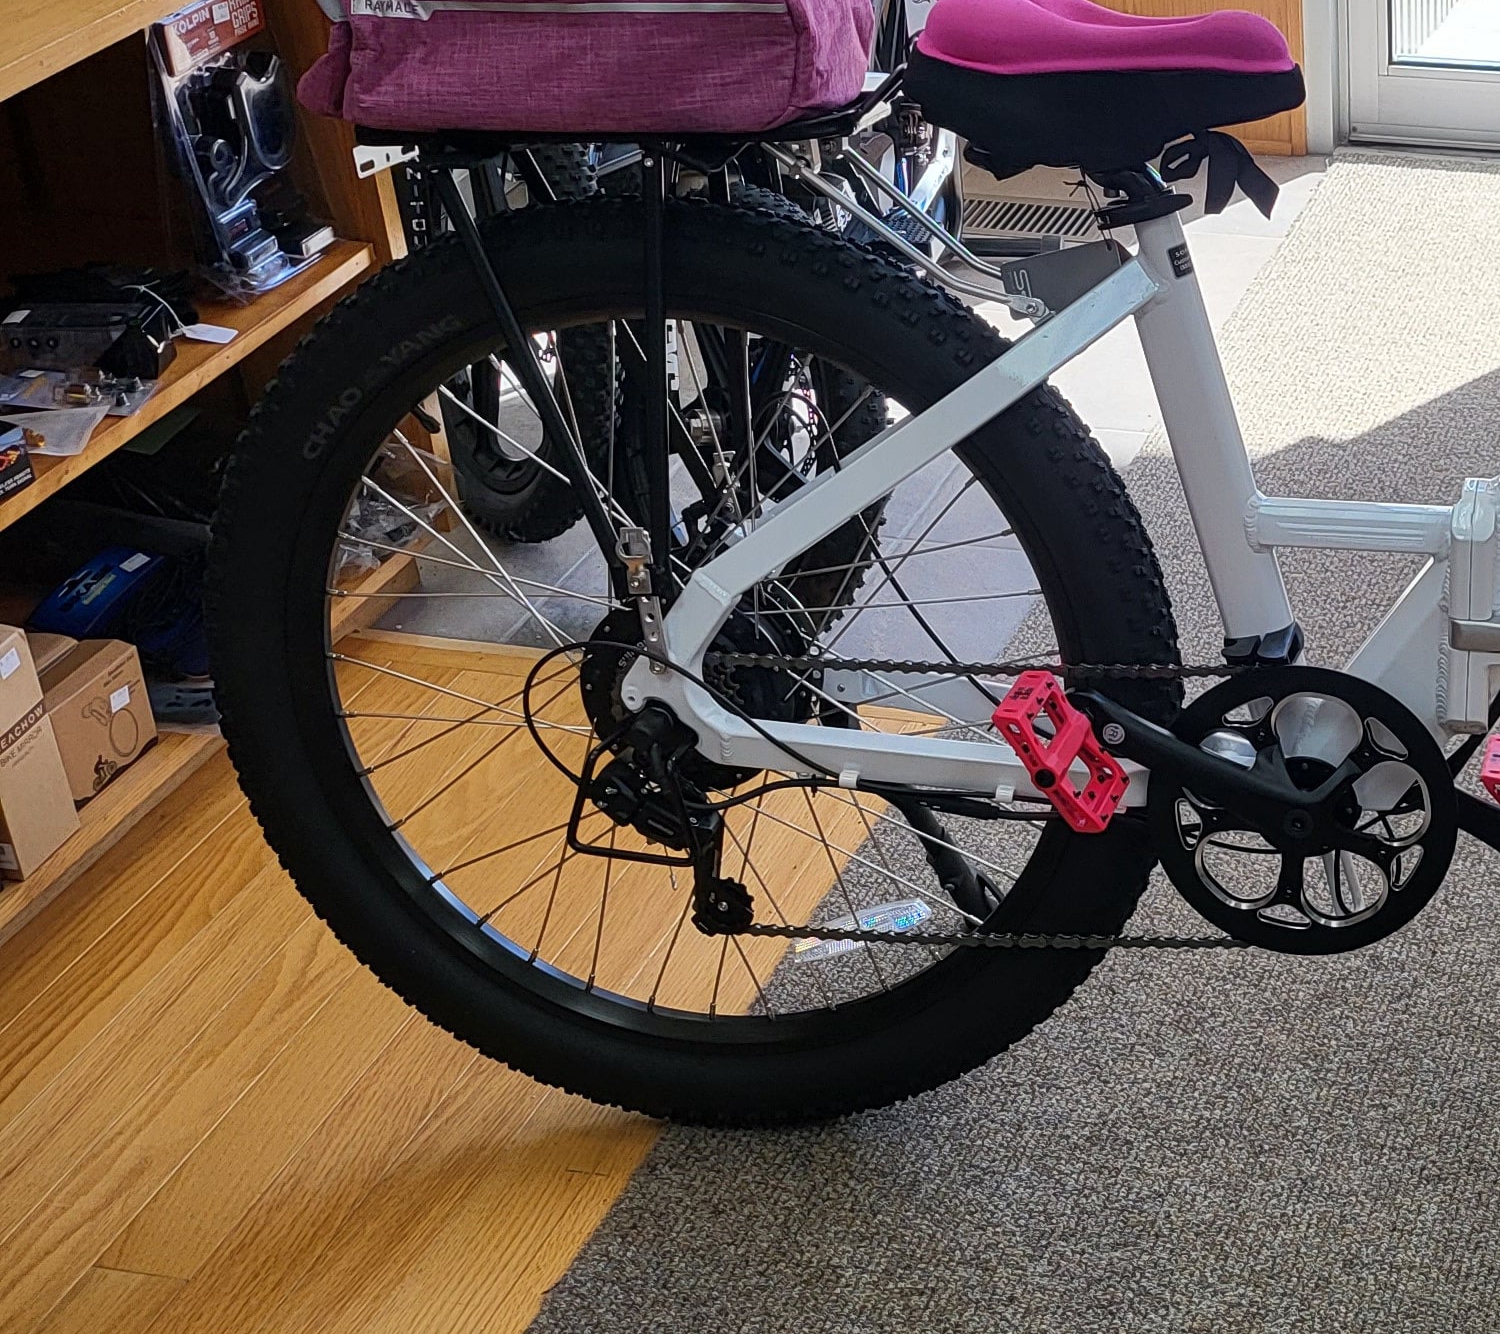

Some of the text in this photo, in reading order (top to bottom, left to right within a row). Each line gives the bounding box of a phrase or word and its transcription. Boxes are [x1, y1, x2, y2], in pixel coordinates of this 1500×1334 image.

[171, 7, 210, 36] KOLPIN
[231, 1, 258, 28] GRIPS
[404, 157, 429, 250] NITOU
[302, 313, 466, 461] CHAO YANG
